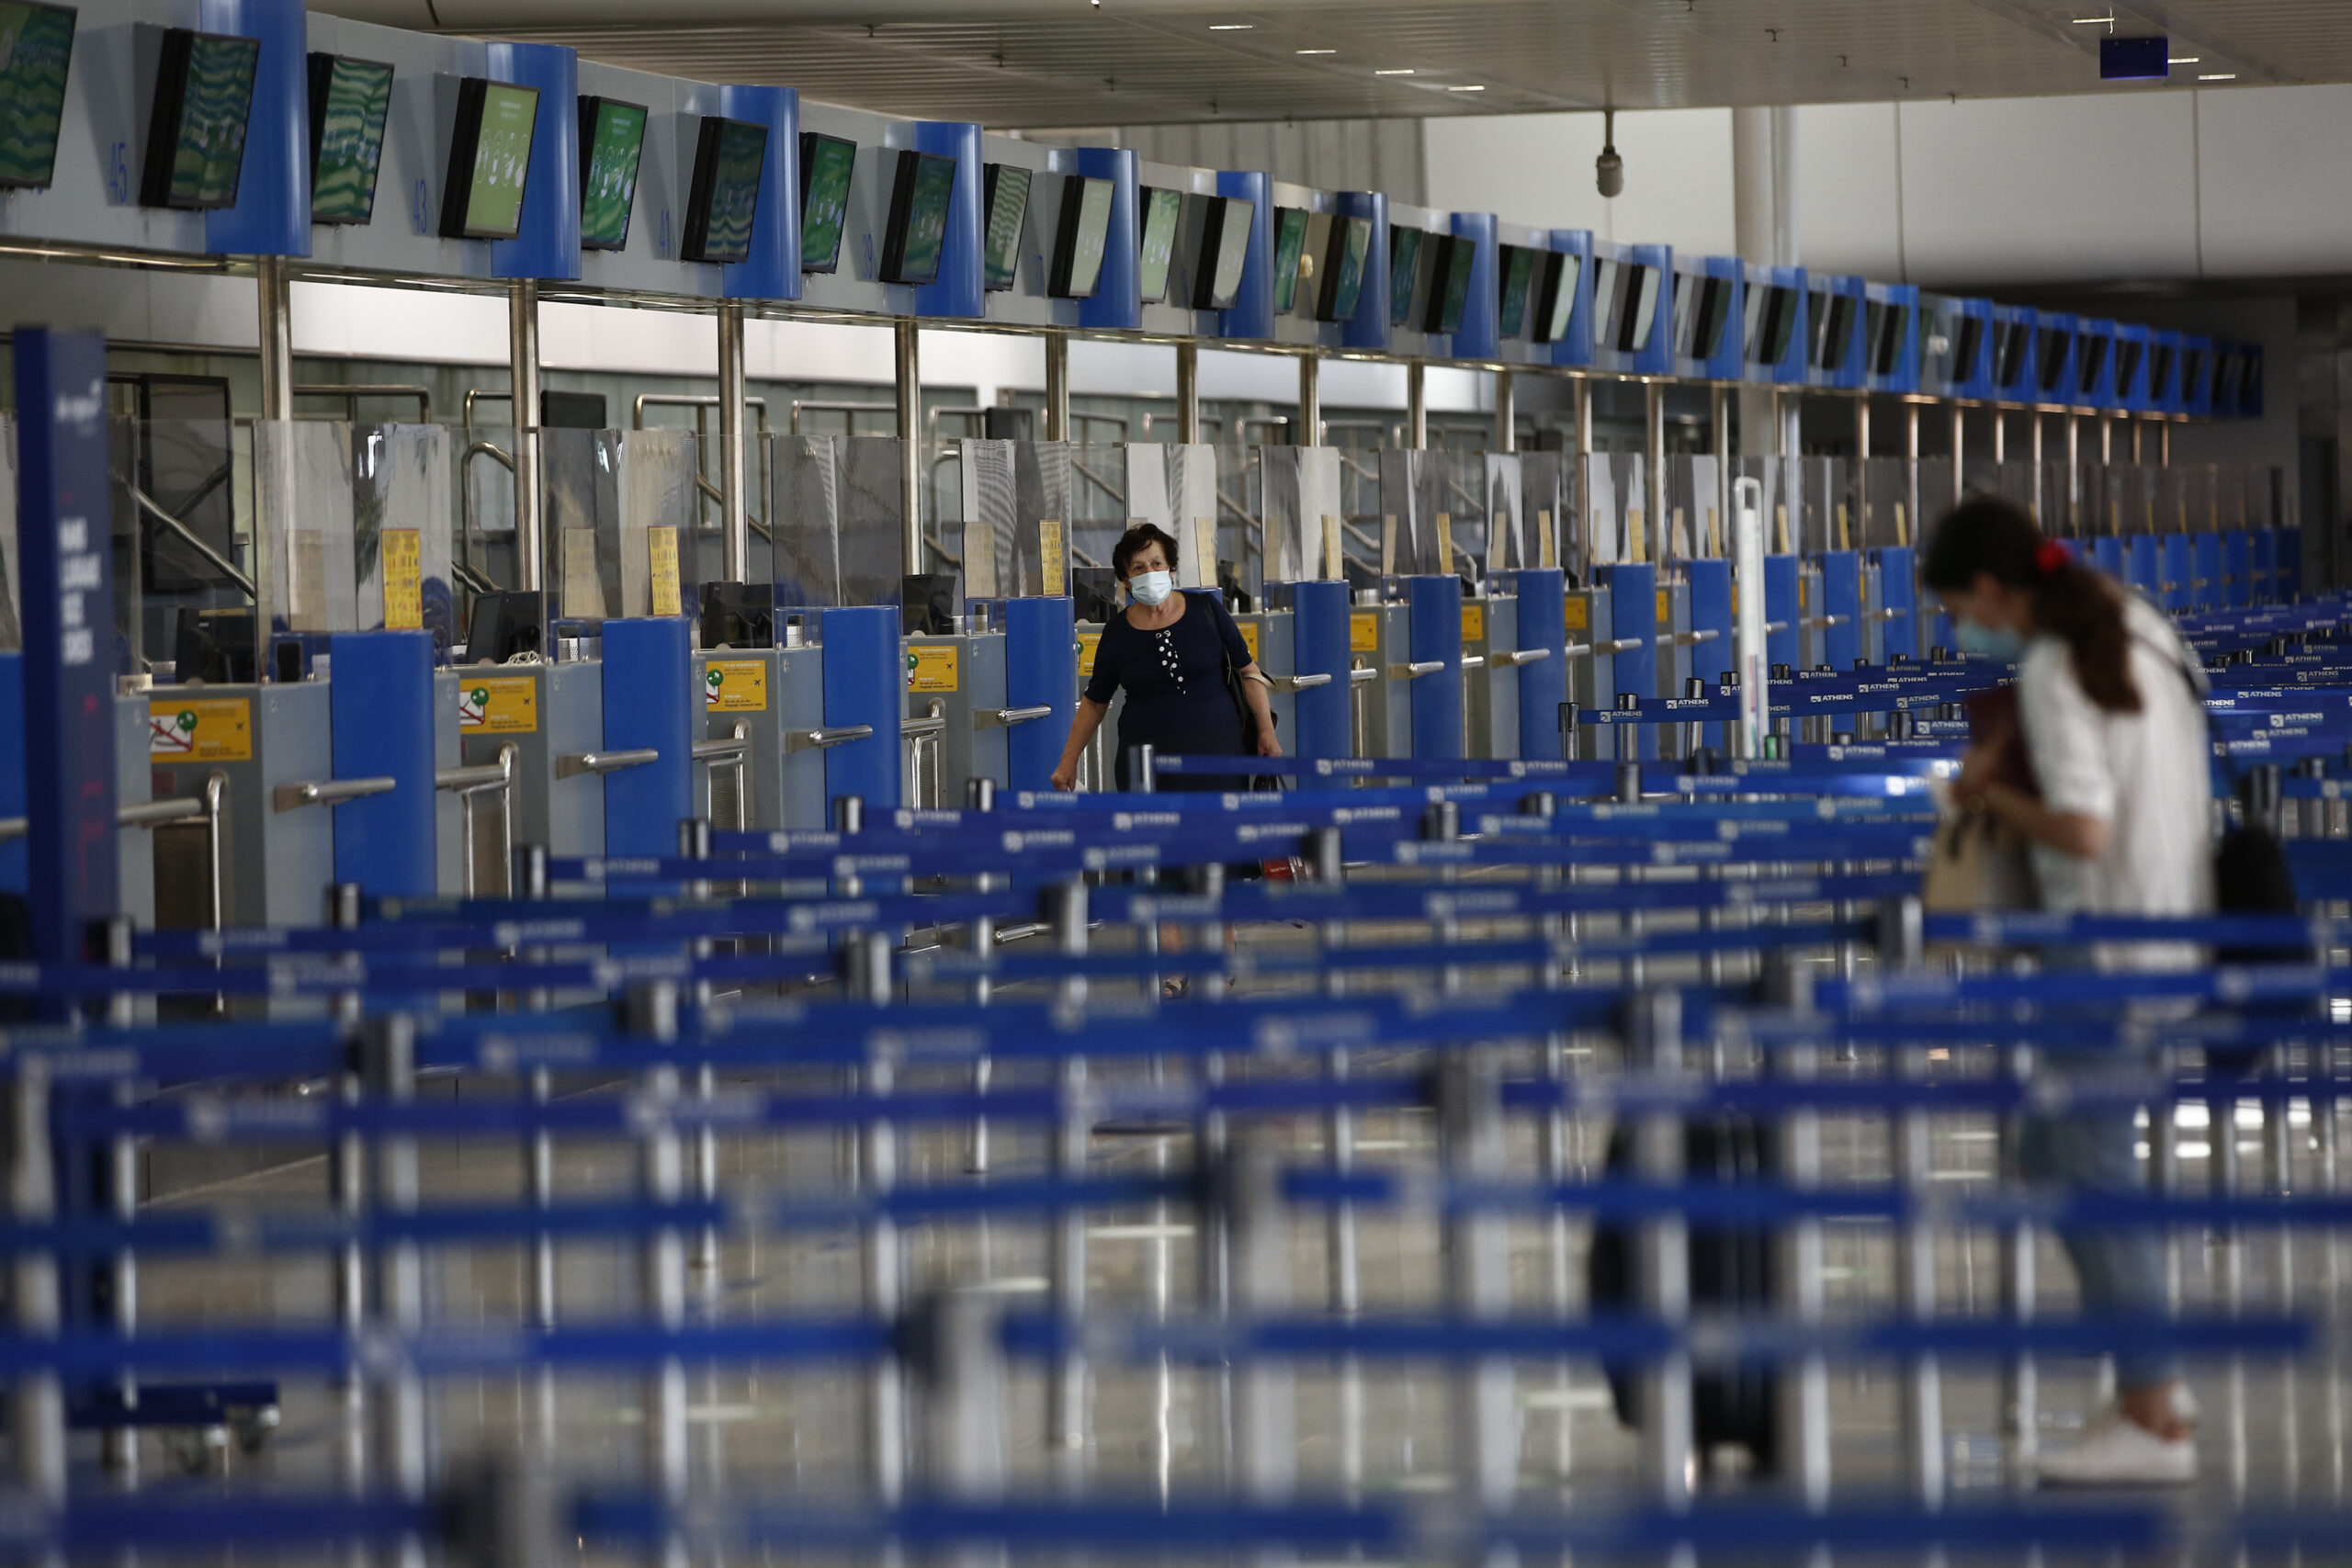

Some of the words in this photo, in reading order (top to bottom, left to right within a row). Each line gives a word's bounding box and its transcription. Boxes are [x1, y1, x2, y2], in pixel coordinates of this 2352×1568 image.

[110, 141, 127, 203] 45
[413, 179, 427, 233] 43
[2285, 713, 2324, 721] ATHENS
[1845, 746, 1886, 755] ATHENS
